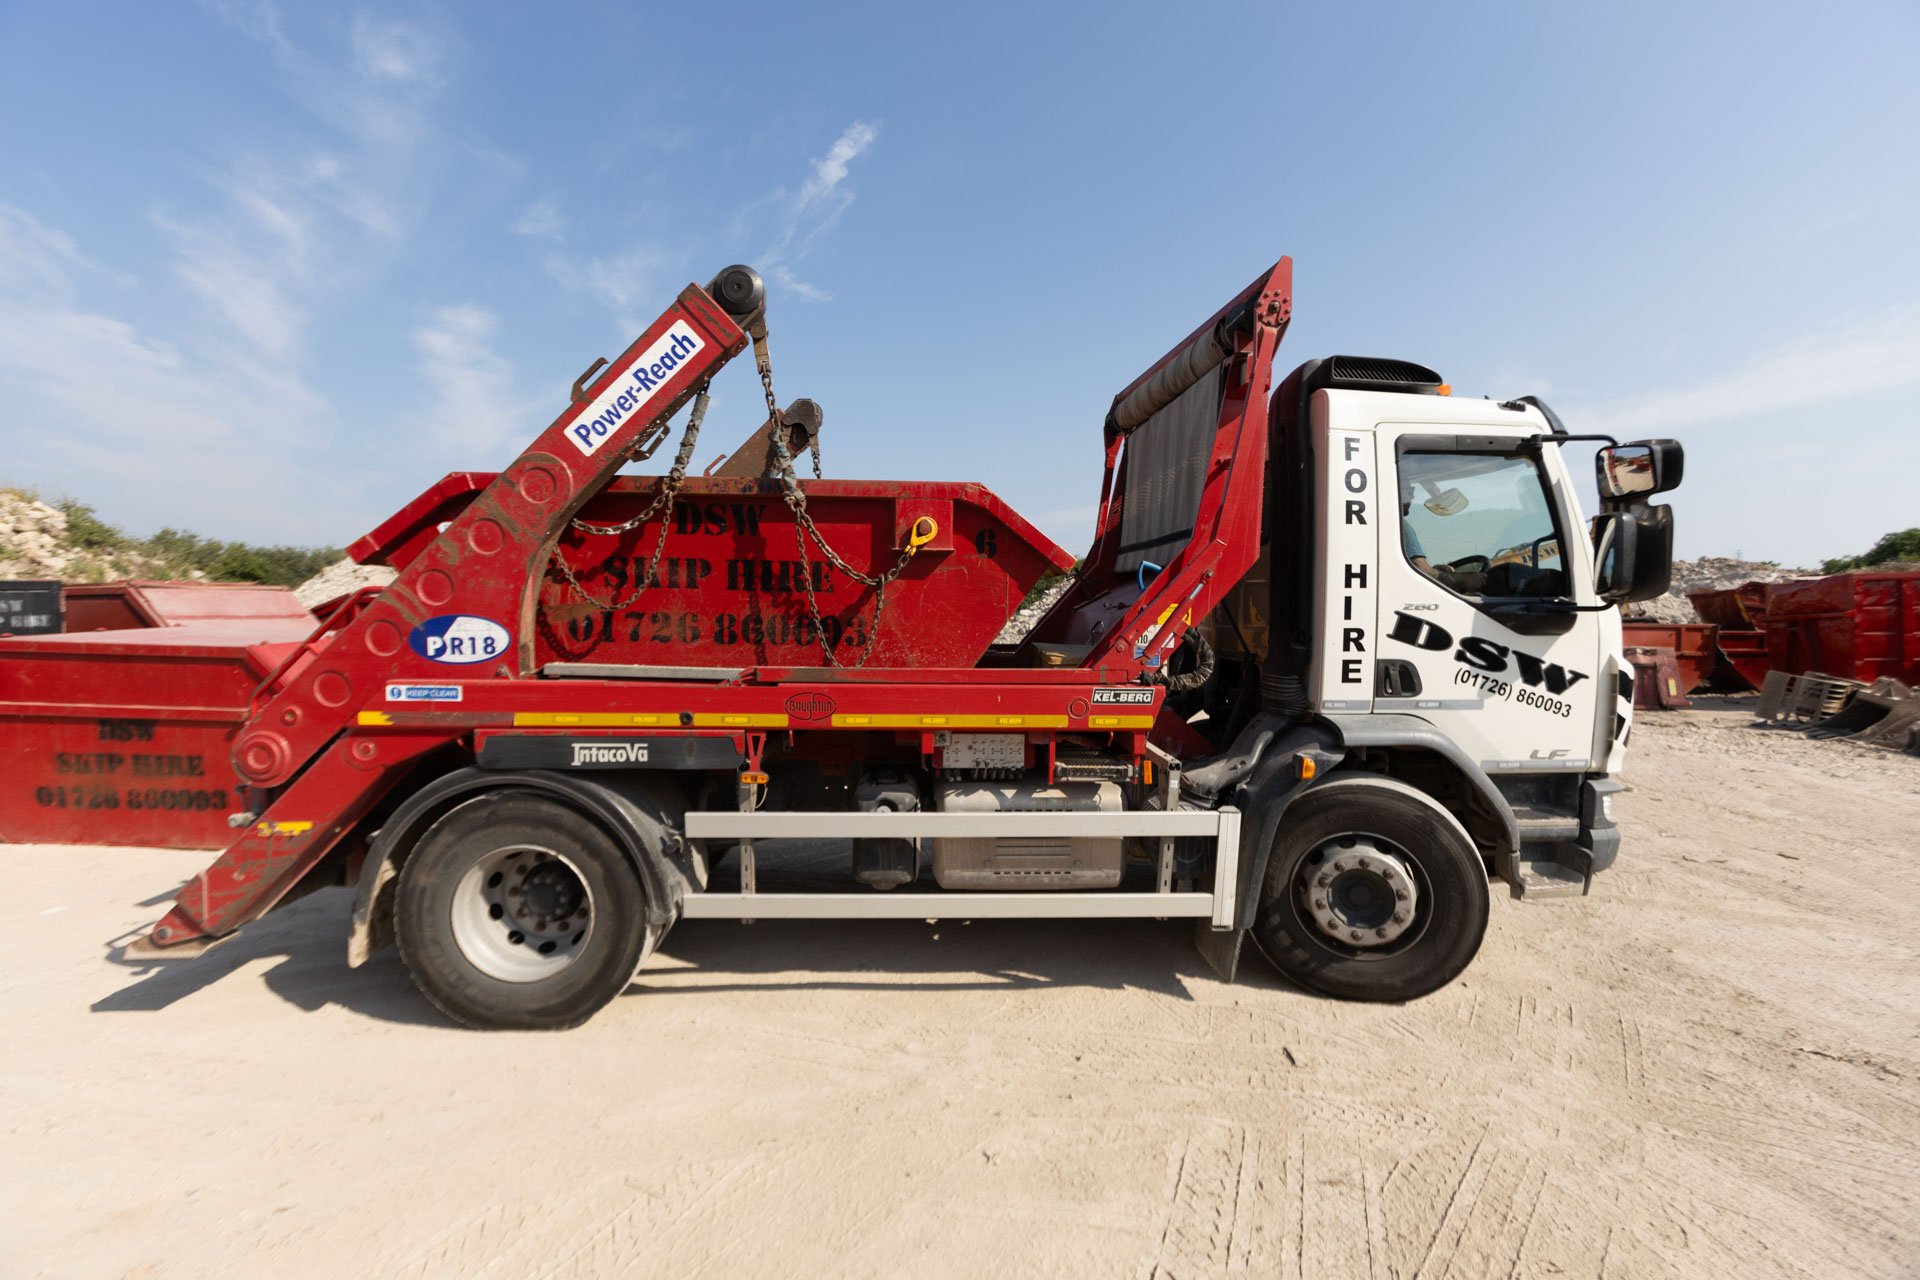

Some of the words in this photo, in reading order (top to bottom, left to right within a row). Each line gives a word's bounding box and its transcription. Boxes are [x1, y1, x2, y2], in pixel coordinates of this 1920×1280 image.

[573, 333, 697, 448] Power-Reach
[1344, 437, 1367, 525] FOR
[675, 502, 766, 536] DSW
[975, 528, 997, 559] 6
[604, 556, 711, 590] SKIP
[726, 559, 834, 594] HIRE
[568, 610, 700, 643] 01726
[713, 612, 867, 647] 860093
[1341, 564, 1367, 684] HIRE
[426, 636, 496, 657] PR18
[1386, 611, 1590, 695] DSW
[407, 689, 429, 697] KEEP
[430, 689, 457, 698] CLEAR
[1454, 667, 1513, 702] (01726)
[1516, 688, 1572, 718] 860093
[1530, 749, 1571, 761] LF
